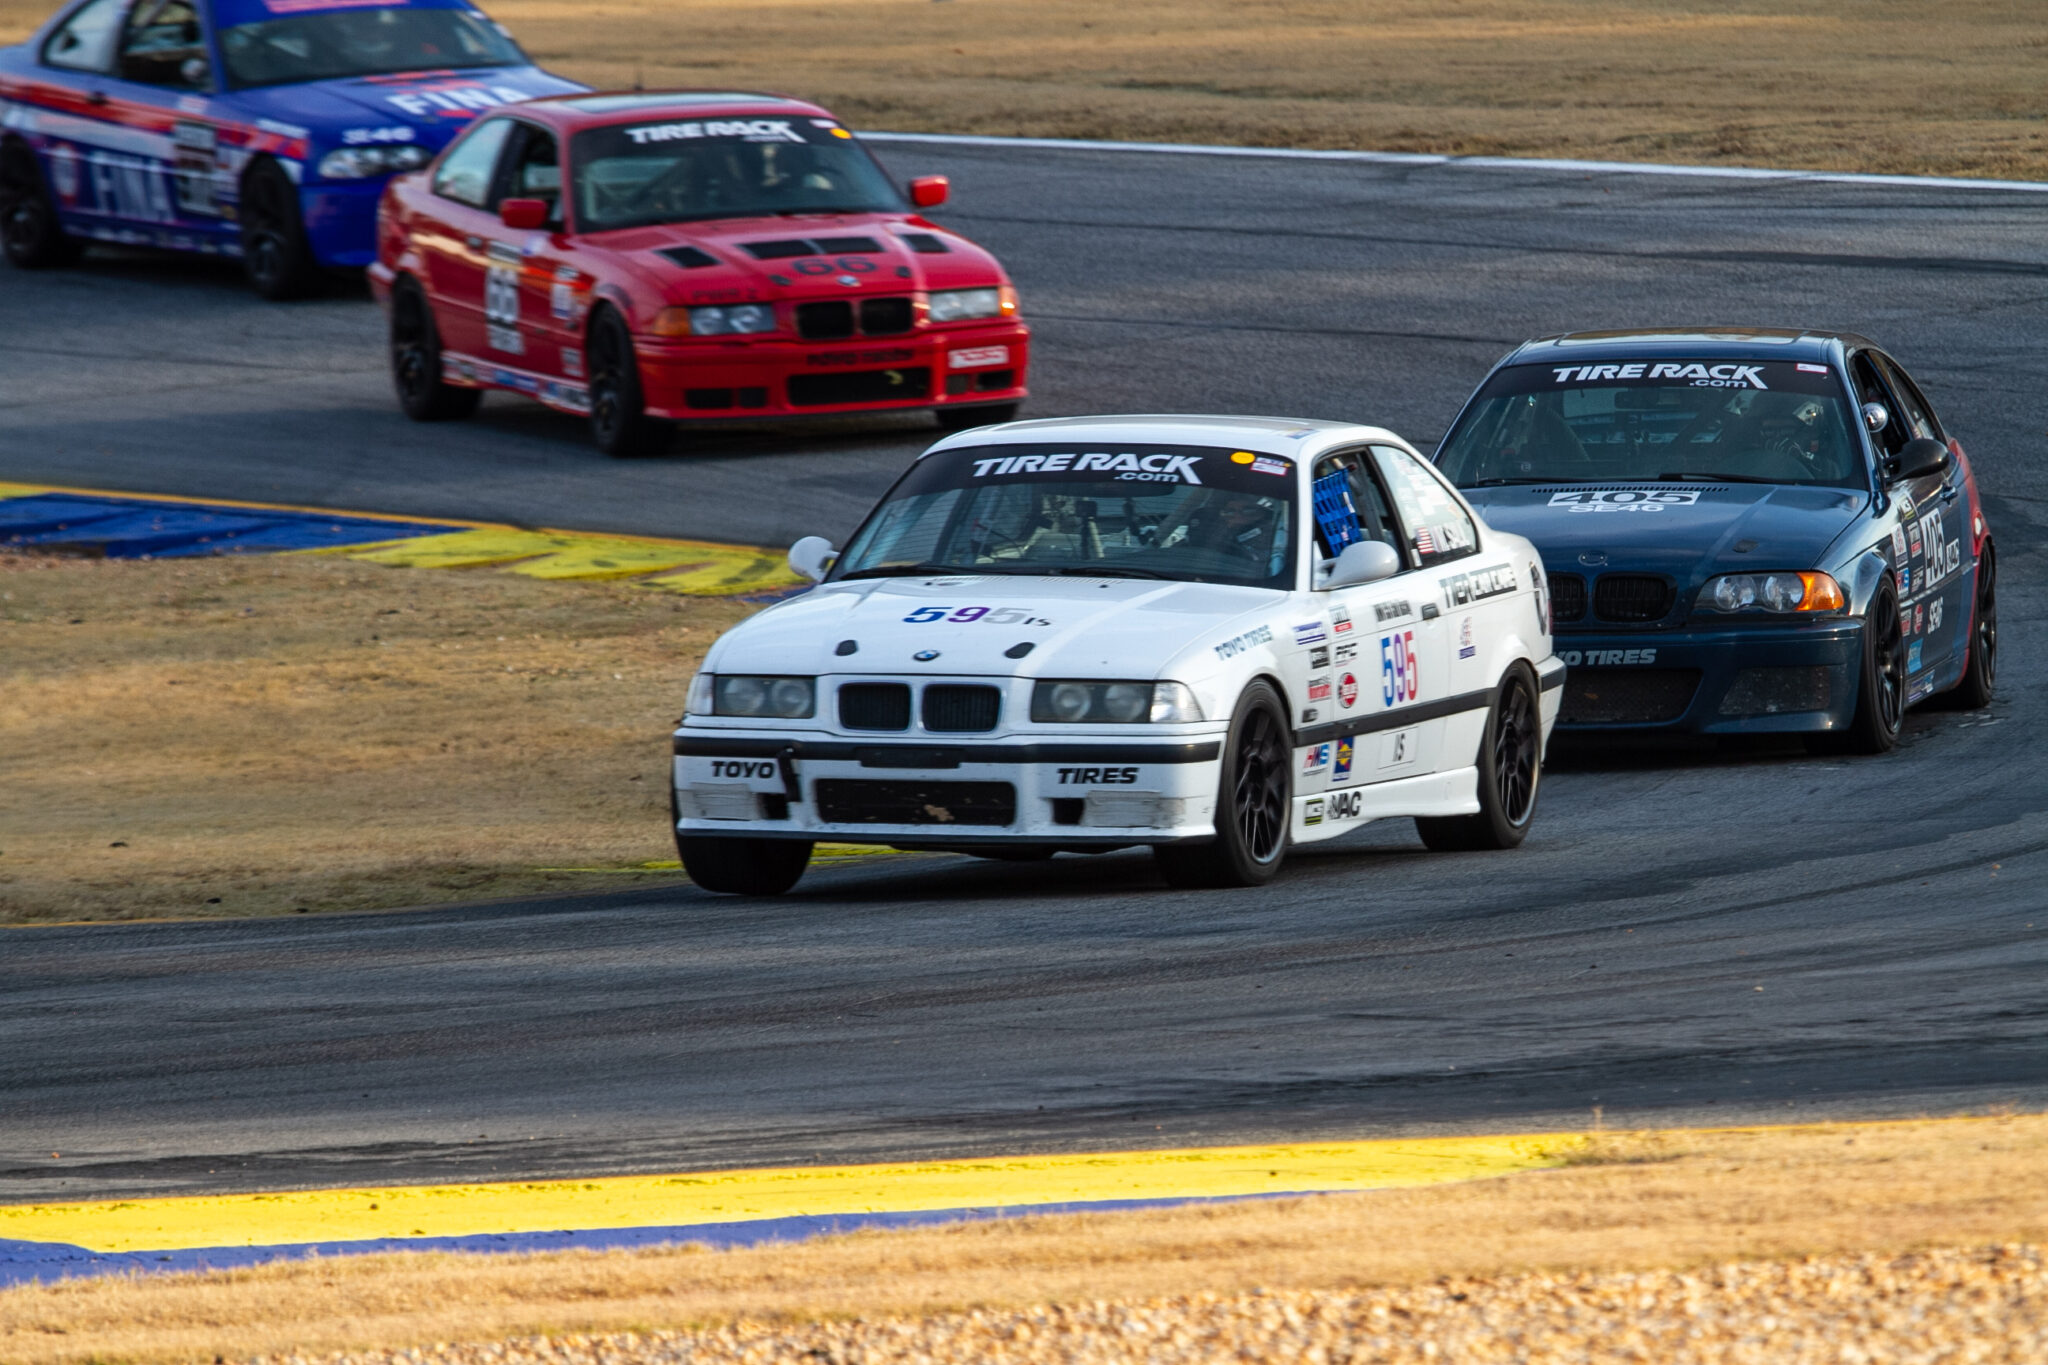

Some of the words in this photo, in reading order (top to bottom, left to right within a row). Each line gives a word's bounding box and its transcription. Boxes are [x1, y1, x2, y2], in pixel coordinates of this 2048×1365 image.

[386, 86, 531, 114] FINA
[624, 122, 705, 144] TIRE
[706, 119, 808, 143] RACK
[792, 255, 877, 276] 66
[1552, 364, 1648, 383] TIRE
[1648, 363, 1768, 389] RACK
[1689, 379, 1748, 388] .com
[972, 453, 1074, 477] TIRE
[1073, 453, 1204, 484] RACK
[1115, 471, 1180, 482] .com
[1552, 491, 1695, 504] 405
[1568, 503, 1665, 512] SE46
[1924, 513, 1945, 582] 405
[902, 606, 1035, 624] 595
[1927, 596, 1944, 635] SE46
[1380, 630, 1418, 708] 595
[1585, 648, 1657, 666] TIRES
[711, 760, 775, 779] TOYO
[1056, 767, 1140, 784] TIRES
